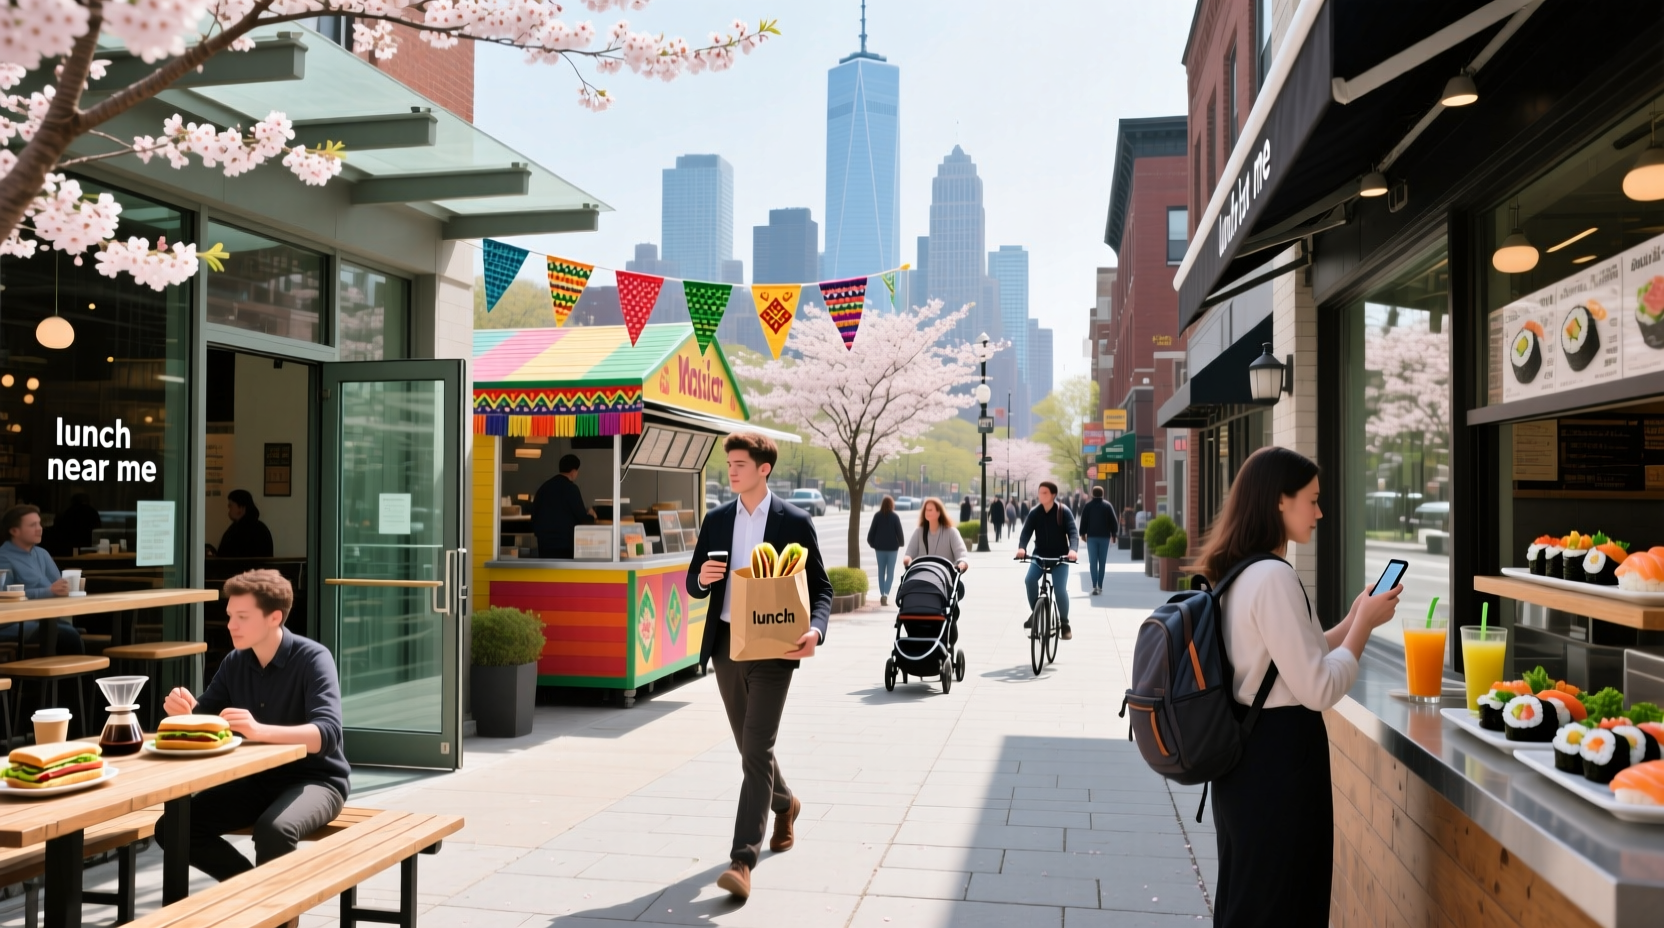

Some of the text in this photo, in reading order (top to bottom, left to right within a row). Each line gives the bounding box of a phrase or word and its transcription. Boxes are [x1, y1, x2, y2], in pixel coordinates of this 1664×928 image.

[1253, 138, 1271, 200] me
[56, 416, 132, 449] lunch
[47, 458, 157, 483] near me
